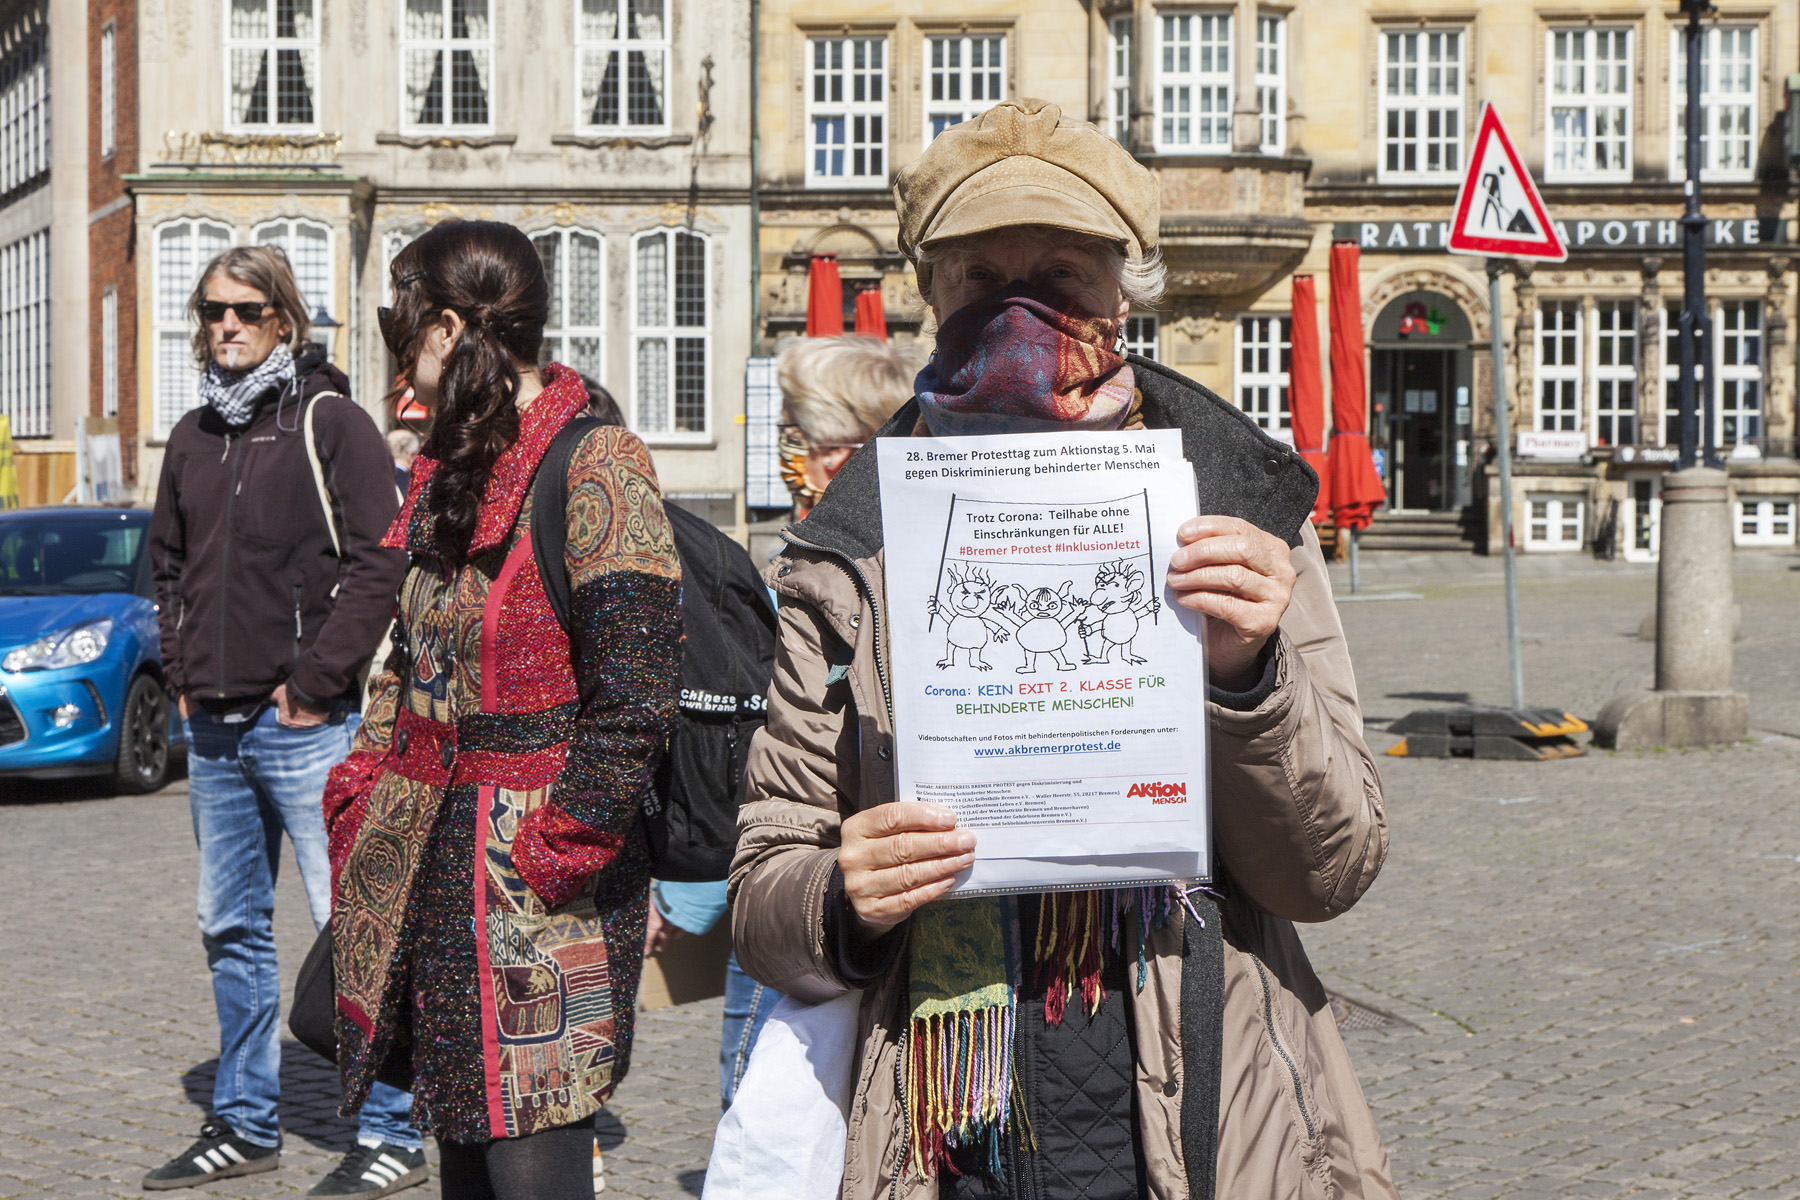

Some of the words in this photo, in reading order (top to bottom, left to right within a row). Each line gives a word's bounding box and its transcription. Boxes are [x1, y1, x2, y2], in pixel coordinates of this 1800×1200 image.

[1555, 220, 1760, 245] APOTHKE
[906, 451, 923, 461] 28.
[926, 451, 968, 461] Bremer
[971, 449, 1030, 460] Protesttag
[1033, 448, 1057, 457] zum
[1060, 445, 1120, 456] Aktionstag
[1122, 444, 1132, 454] 5.
[1134, 443, 1156, 454] Mai
[905, 469, 938, 480] gegen
[941, 466, 1031, 477] Diskriminierung
[1034, 462, 1101, 474] behinderter
[1104, 459, 1160, 470] Menschen
[966, 513, 995, 523] Trotz
[998, 512, 1043, 522] Corona:
[1049, 508, 1098, 520] Teilhabe
[1101, 507, 1130, 517] ohne
[974, 526, 1070, 539] Einschränkungen
[1073, 524, 1090, 535] für
[1092, 522, 1124, 535] ALLE!
[959, 545, 1008, 556] #Bremer
[1011, 543, 1052, 555] Protest
[1055, 540, 1141, 553] #InklusionJetzt
[924, 685, 971, 697] Corona:
[978, 684, 1013, 696] KEIN
[1019, 682, 1053, 695] EXIT
[1059, 681, 1073, 693] 2.
[1080, 678, 1132, 692] KLASSE
[1138, 675, 1166, 689] FÜR
[681, 688, 736, 704] Chinese
[679, 699, 702, 710] own
[704, 701, 737, 712] brand
[956, 700, 1046, 715] BEHINDERTE
[1052, 696, 1134, 711] MENSCHEN!
[918, 734, 977, 742] Videobotschaften
[978, 734, 993, 742] und
[1028, 730, 1109, 740] behindertenpolitischen
[1111, 727, 1155, 737] Forderungen
[1157, 726, 1179, 734] unter:
[974, 740, 1121, 757] www.akbremerprotest.de
[1152, 796, 1187, 805] MENSCH
